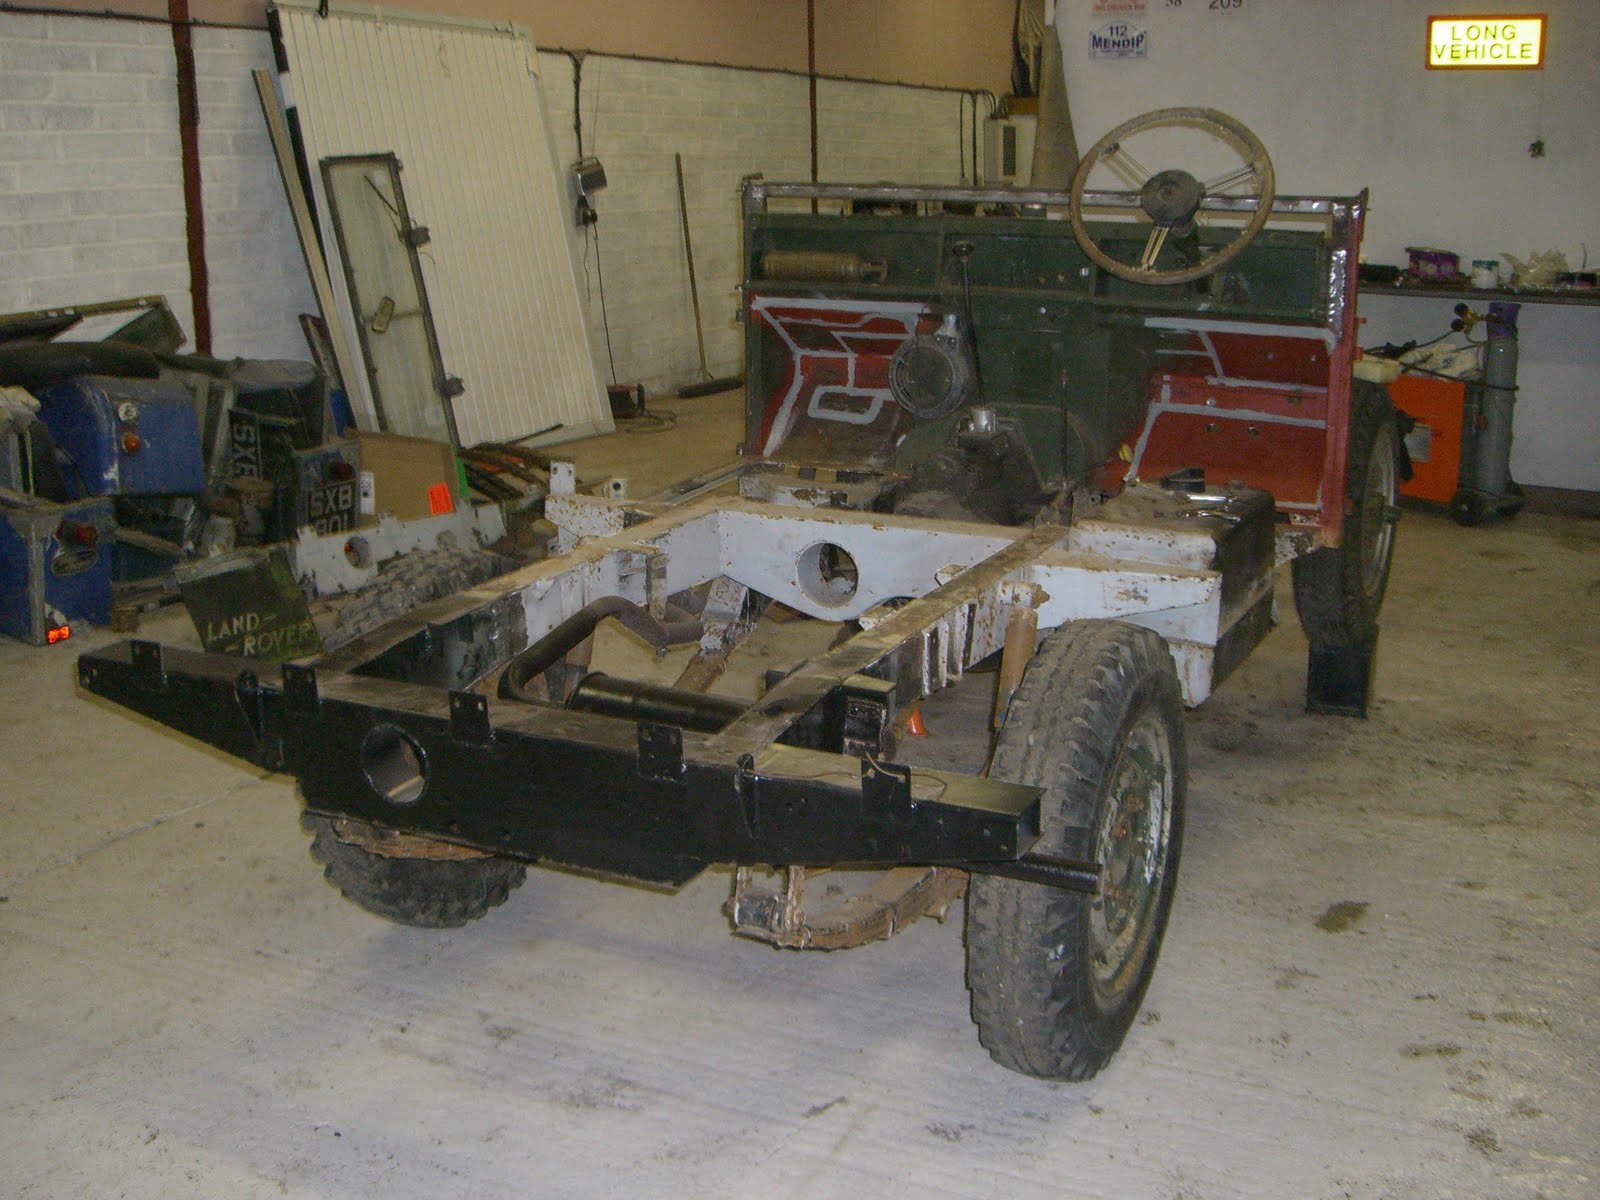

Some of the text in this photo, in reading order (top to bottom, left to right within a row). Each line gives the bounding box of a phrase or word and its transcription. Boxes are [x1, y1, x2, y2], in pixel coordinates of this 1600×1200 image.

[1109, 25, 1128, 37] 112
[1451, 25, 1517, 41] LONG
[1091, 34, 1145, 49] MENDIP
[1434, 43, 1533, 59] VEHICLE
